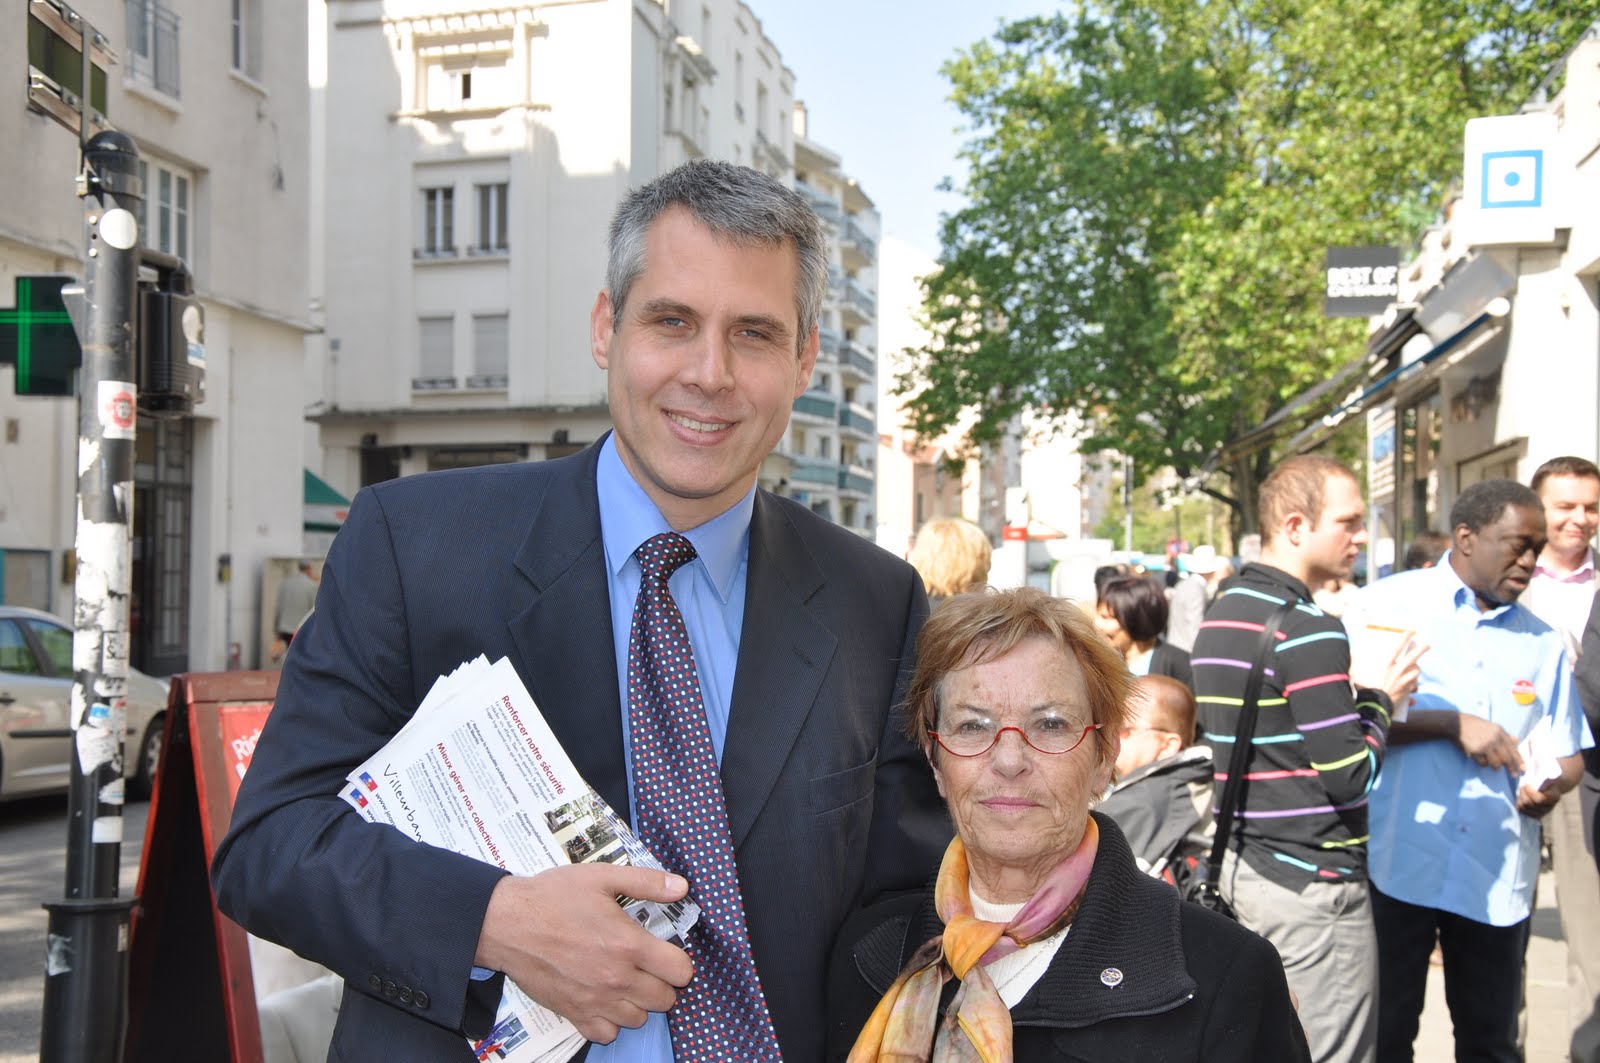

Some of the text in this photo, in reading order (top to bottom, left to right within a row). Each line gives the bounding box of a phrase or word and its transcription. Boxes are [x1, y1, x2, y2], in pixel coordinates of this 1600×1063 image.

[501, 694, 566, 795] Renforcer notre sécurité
[384, 762, 423, 842] Villeurban
[436, 741, 454, 770] Mieux
[448, 769, 466, 794] gérer
[461, 794, 474, 811] nos
[470, 811, 503, 861] collectivités
